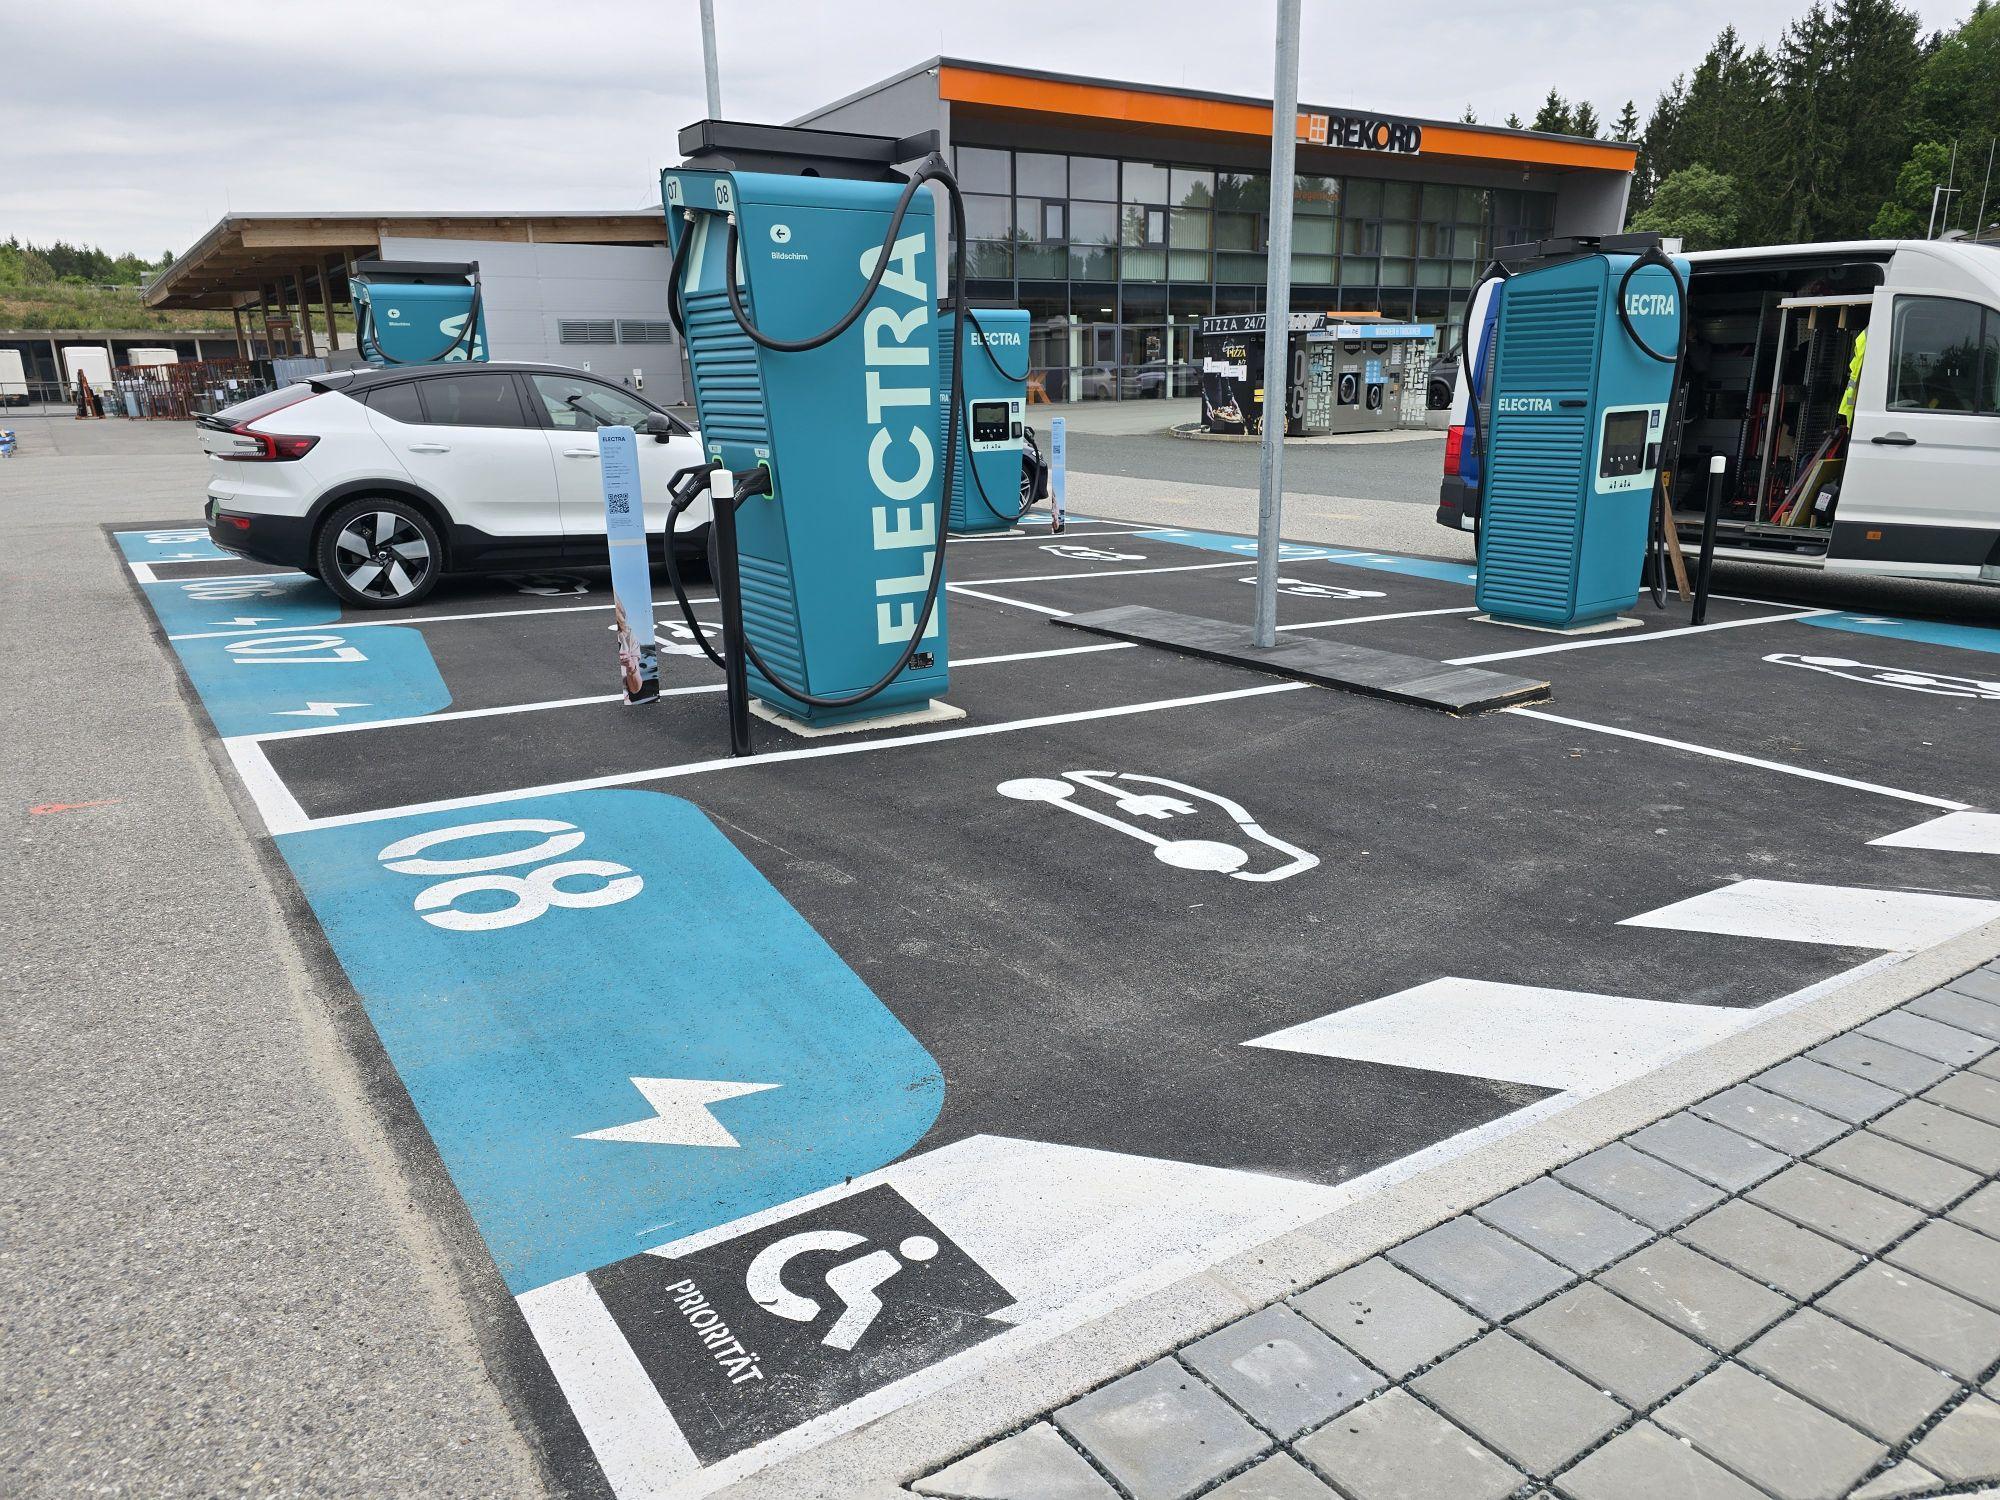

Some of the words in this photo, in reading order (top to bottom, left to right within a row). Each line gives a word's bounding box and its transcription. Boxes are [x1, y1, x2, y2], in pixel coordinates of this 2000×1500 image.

[1327, 116, 1421, 153] REKORD
[667, 182, 677, 199] 07
[716, 185, 729, 204] 08
[771, 251, 808, 260] Bildschirm
[1616, 294, 1674, 315] LECTRA
[1203, 319, 1238, 331] PIZZA
[1244, 316, 1265, 329] 24/7
[970, 332, 1021, 345] ELECTRA
[1498, 398, 1553, 411] ELECTRA
[859, 232, 938, 645] ELECTRA
[180, 580, 288, 600] 06
[224, 635, 369, 664] 07
[377, 818, 644, 931] 08
[665, 1279, 764, 1385] PRIORITÄT
